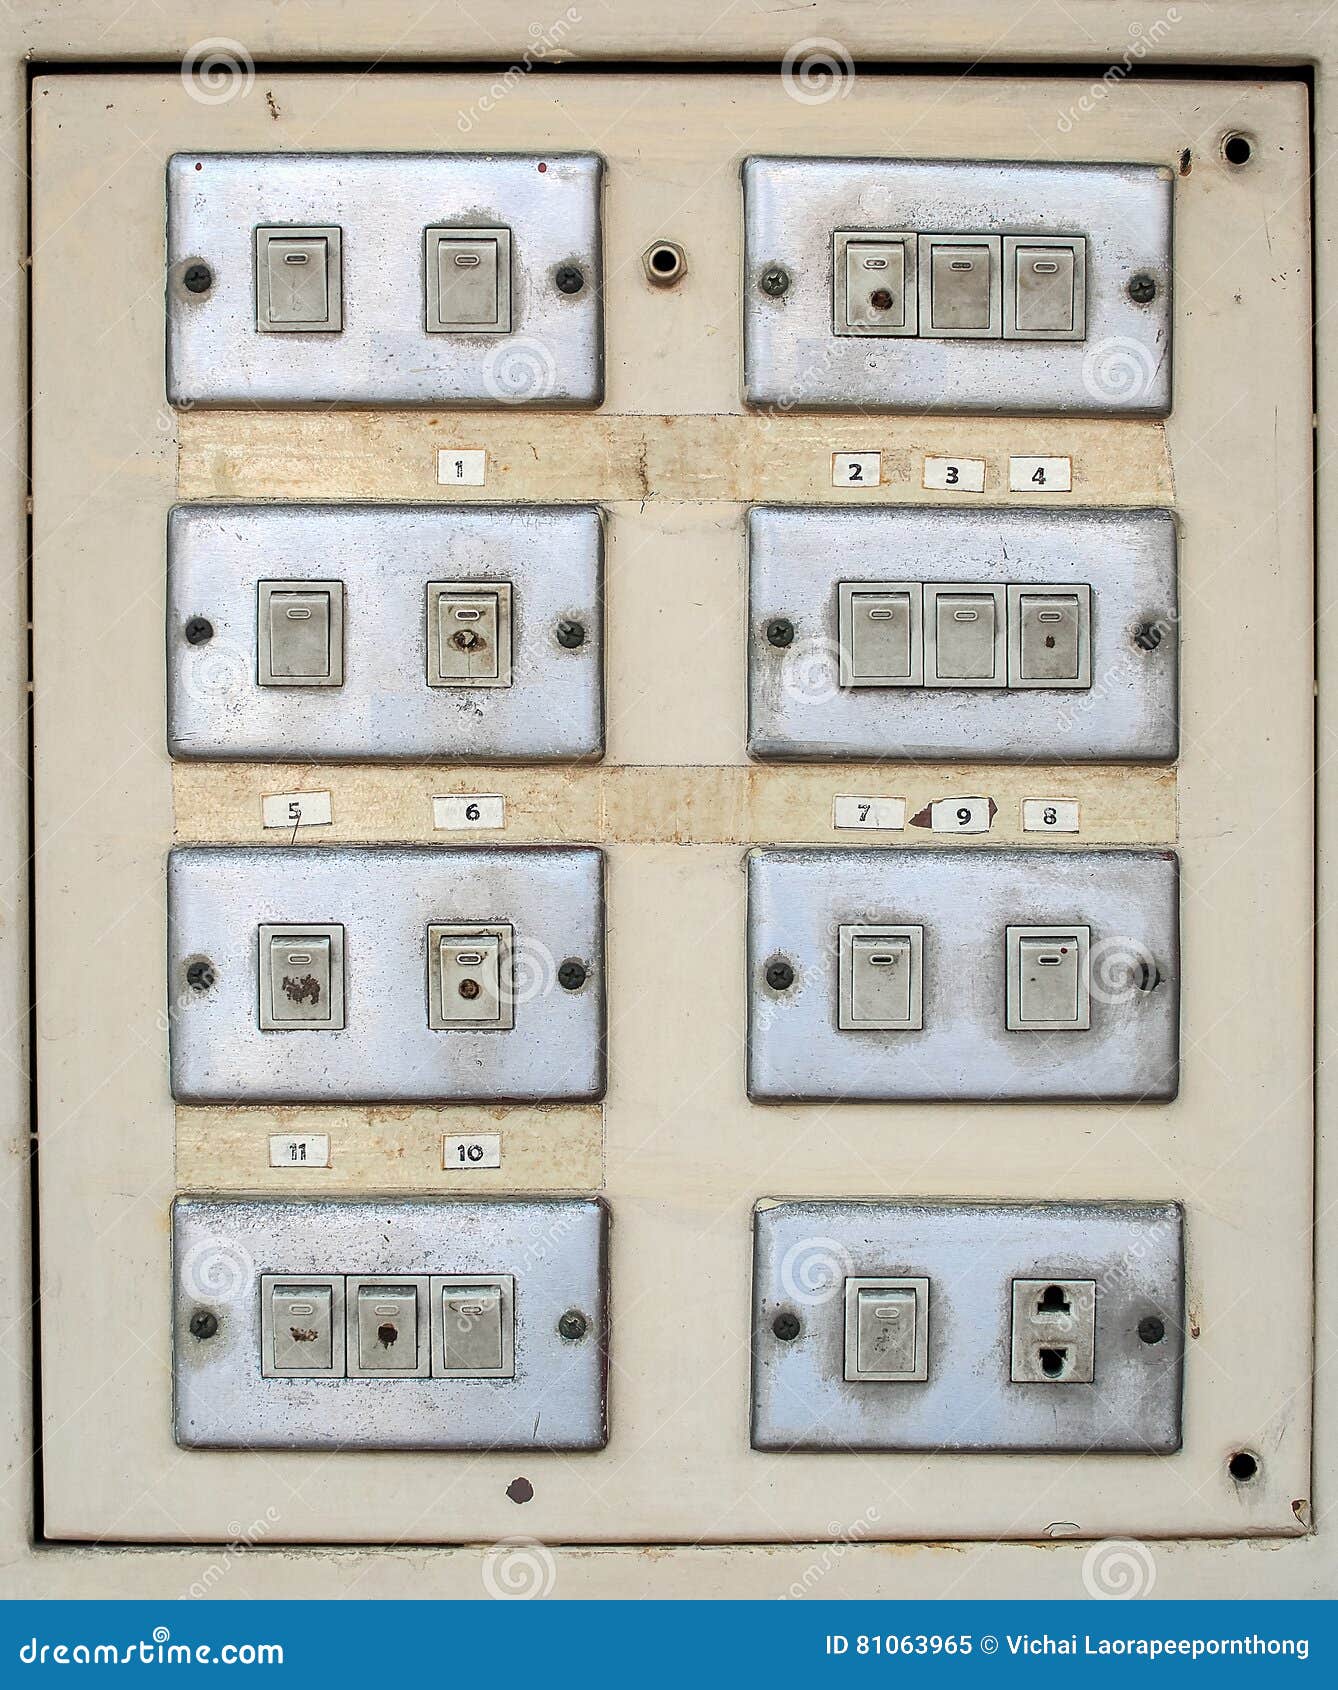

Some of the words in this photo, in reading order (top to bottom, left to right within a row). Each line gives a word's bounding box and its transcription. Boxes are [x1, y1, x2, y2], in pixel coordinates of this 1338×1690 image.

[455, 461, 463, 478] 1
[848, 463, 863, 481] 2
[946, 466, 960, 484] 3
[1031, 467, 1046, 485] 4
[288, 802, 302, 820] 5
[465, 803, 480, 821] 6
[857, 804, 871, 821] 7
[956, 808, 971, 825] 9
[1043, 807, 1057, 825] 8
[289, 1143, 307, 1161] 11
[457, 1145, 484, 1161] 10
